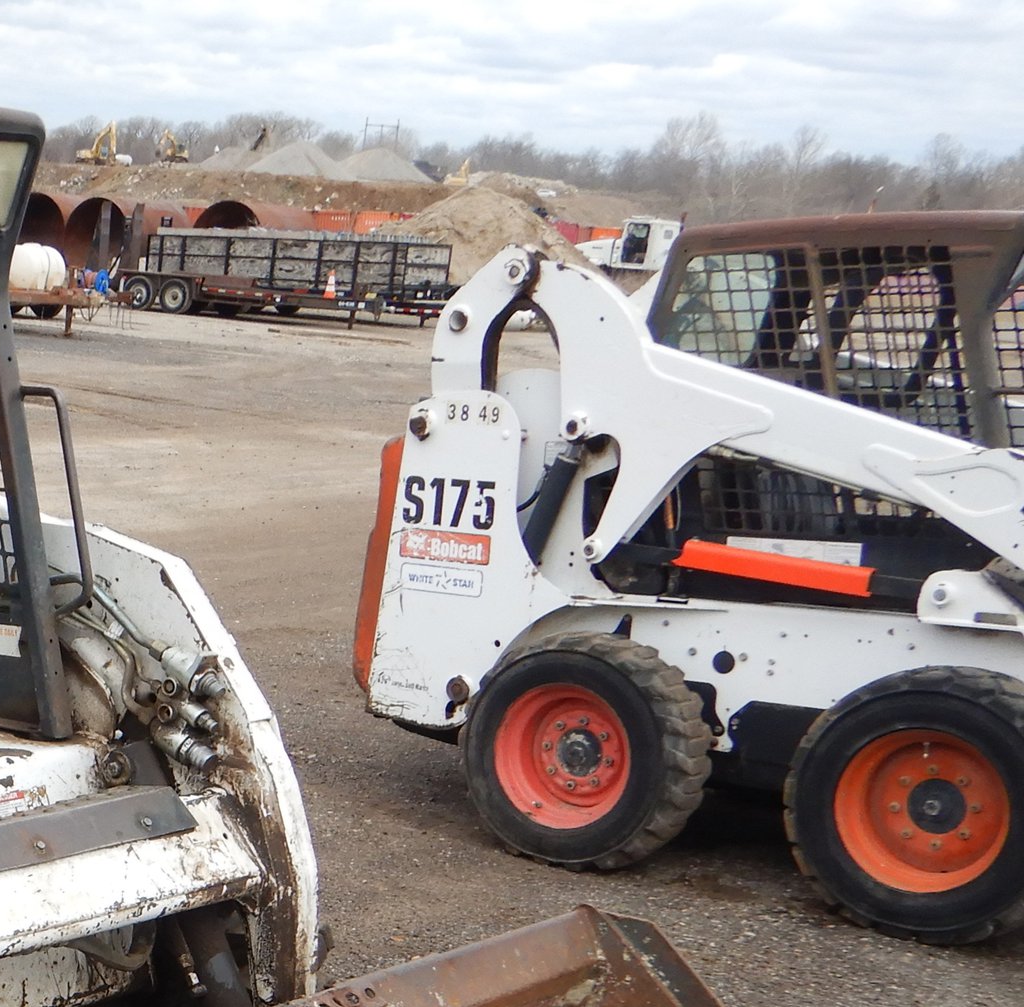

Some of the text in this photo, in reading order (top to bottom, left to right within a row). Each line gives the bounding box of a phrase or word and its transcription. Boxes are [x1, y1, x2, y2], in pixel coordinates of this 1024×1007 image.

[402, 475, 496, 530] S175
[430, 537, 484, 561] Bobcat
[408, 573, 475, 588] WHITE STAR
